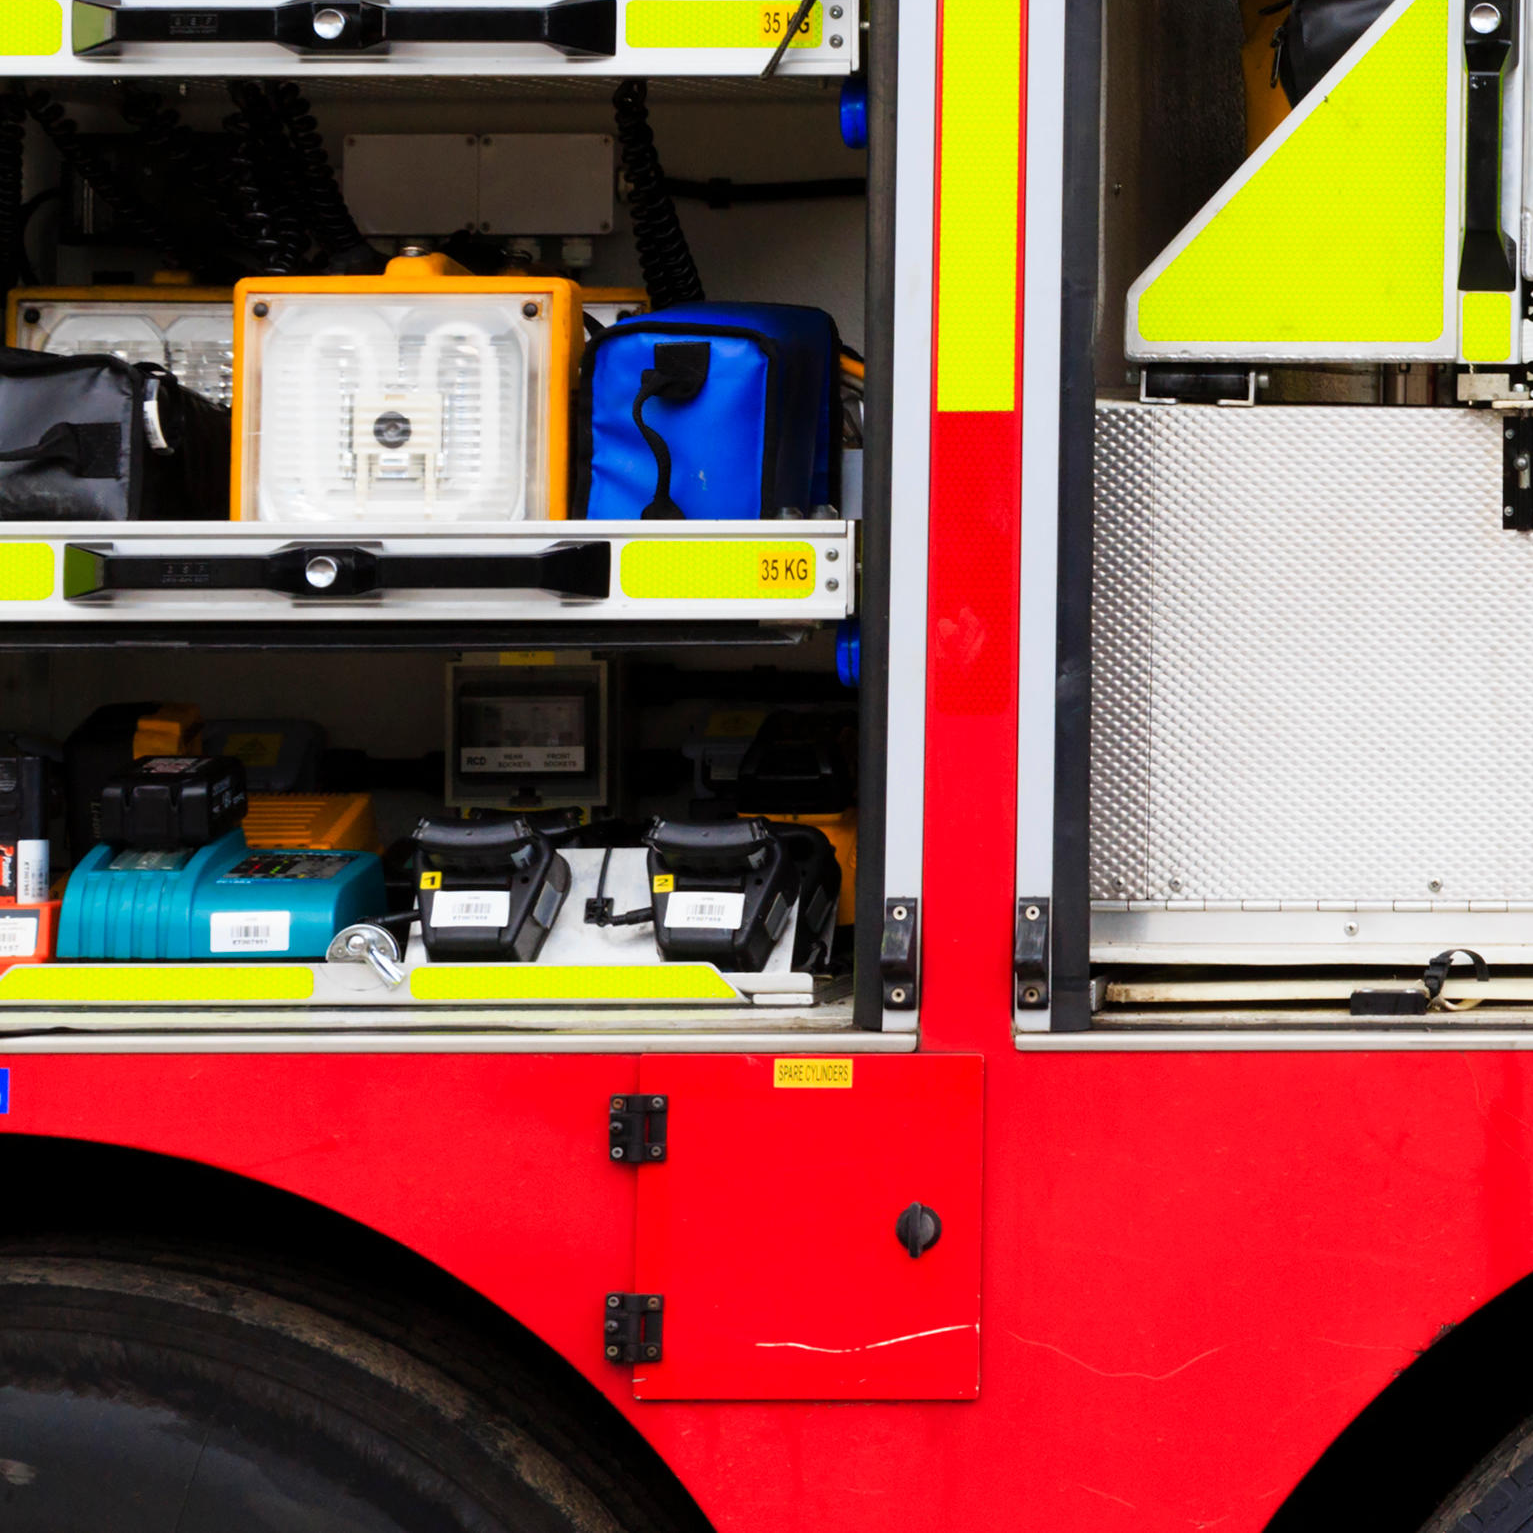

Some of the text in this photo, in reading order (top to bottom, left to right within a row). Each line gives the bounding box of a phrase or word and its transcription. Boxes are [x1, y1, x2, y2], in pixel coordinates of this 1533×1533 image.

[763, 11, 781, 34] 35
[761, 558, 809, 582] 35 KG
[466, 756, 487, 767] RCD
[424, 875, 437, 886] 1
[656, 878, 669, 888] 2
[778, 1064, 849, 1082] SPARE CYLINDERS
